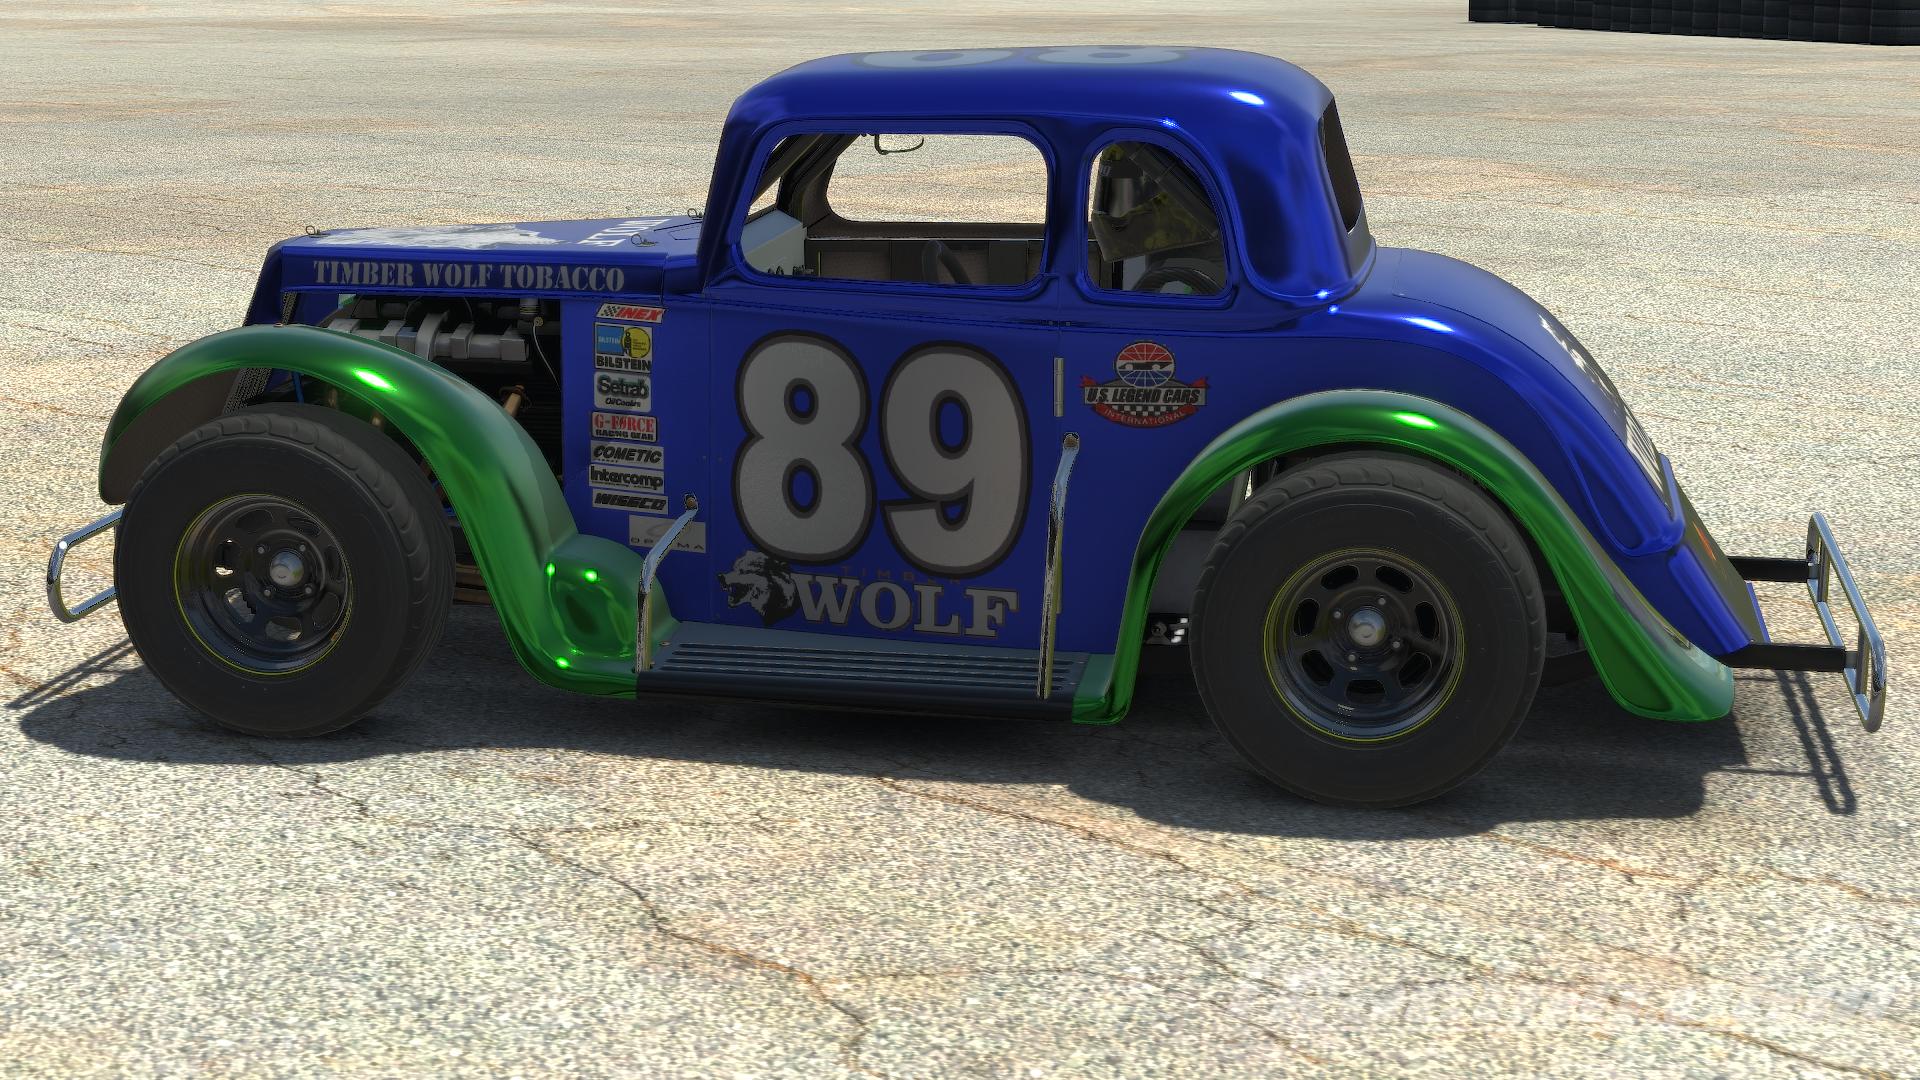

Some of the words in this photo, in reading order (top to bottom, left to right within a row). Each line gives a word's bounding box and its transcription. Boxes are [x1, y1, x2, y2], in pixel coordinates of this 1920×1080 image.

[313, 259, 414, 288] TIMBER
[422, 262, 493, 290] WOLF
[499, 264, 625, 293] TOBACCO
[615, 306, 664, 321] INEX
[596, 356, 651, 371] BILSTEIN
[597, 374, 650, 400] Setrab
[1086, 388, 1109, 403] U.S.
[1111, 388, 1162, 404] LEGEND
[1163, 388, 1201, 404] CARS
[594, 413, 655, 433] G-FORCE
[1104, 407, 1185, 426] INTERNATIONAL
[595, 429, 629, 439] RACING
[630, 432, 654, 441] GEAR
[593, 445, 663, 464] COMETIC
[734, 332, 1032, 578] 89
[594, 493, 666, 510] WISECO
[790, 572, 1018, 637] WOLF
